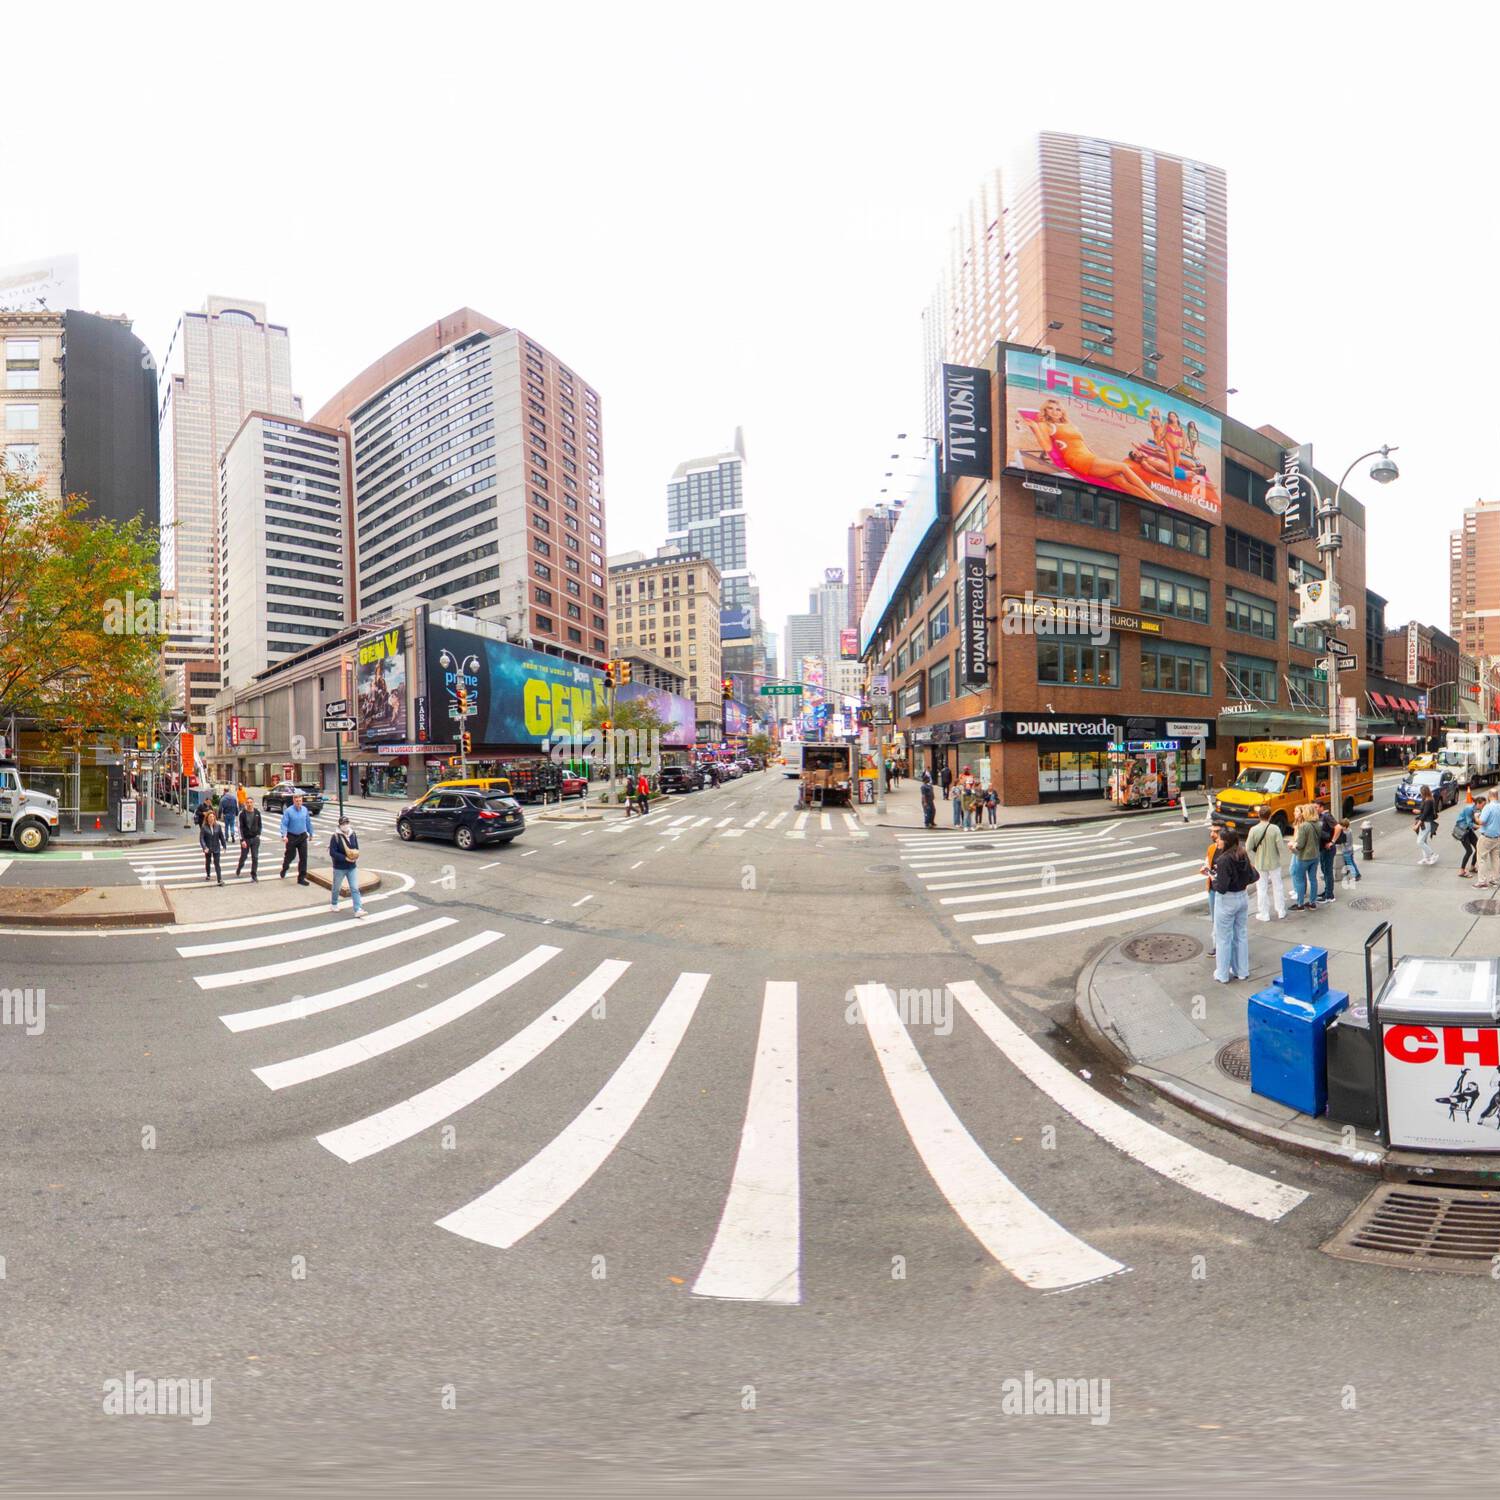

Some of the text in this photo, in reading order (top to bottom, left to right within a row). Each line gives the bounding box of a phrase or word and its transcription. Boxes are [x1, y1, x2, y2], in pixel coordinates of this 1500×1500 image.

[1046, 369, 1150, 416] FBOY
[1067, 392, 1138, 425] ISLAND
[1151, 481, 1183, 500] MONDAYS
[973, 564, 986, 674] DUANEreade
[1013, 602, 1047, 616] TIMES
[1049, 607, 1090, 621] SQUARE
[1101, 614, 1138, 629] CHURCH
[359, 629, 399, 666] GEN V
[445, 672, 478, 687] prme
[776, 686, 785, 694] 52
[873, 686, 887, 695] 25
[523, 677, 592, 736] GEN
[1016, 718, 1116, 736] DUANEreade
